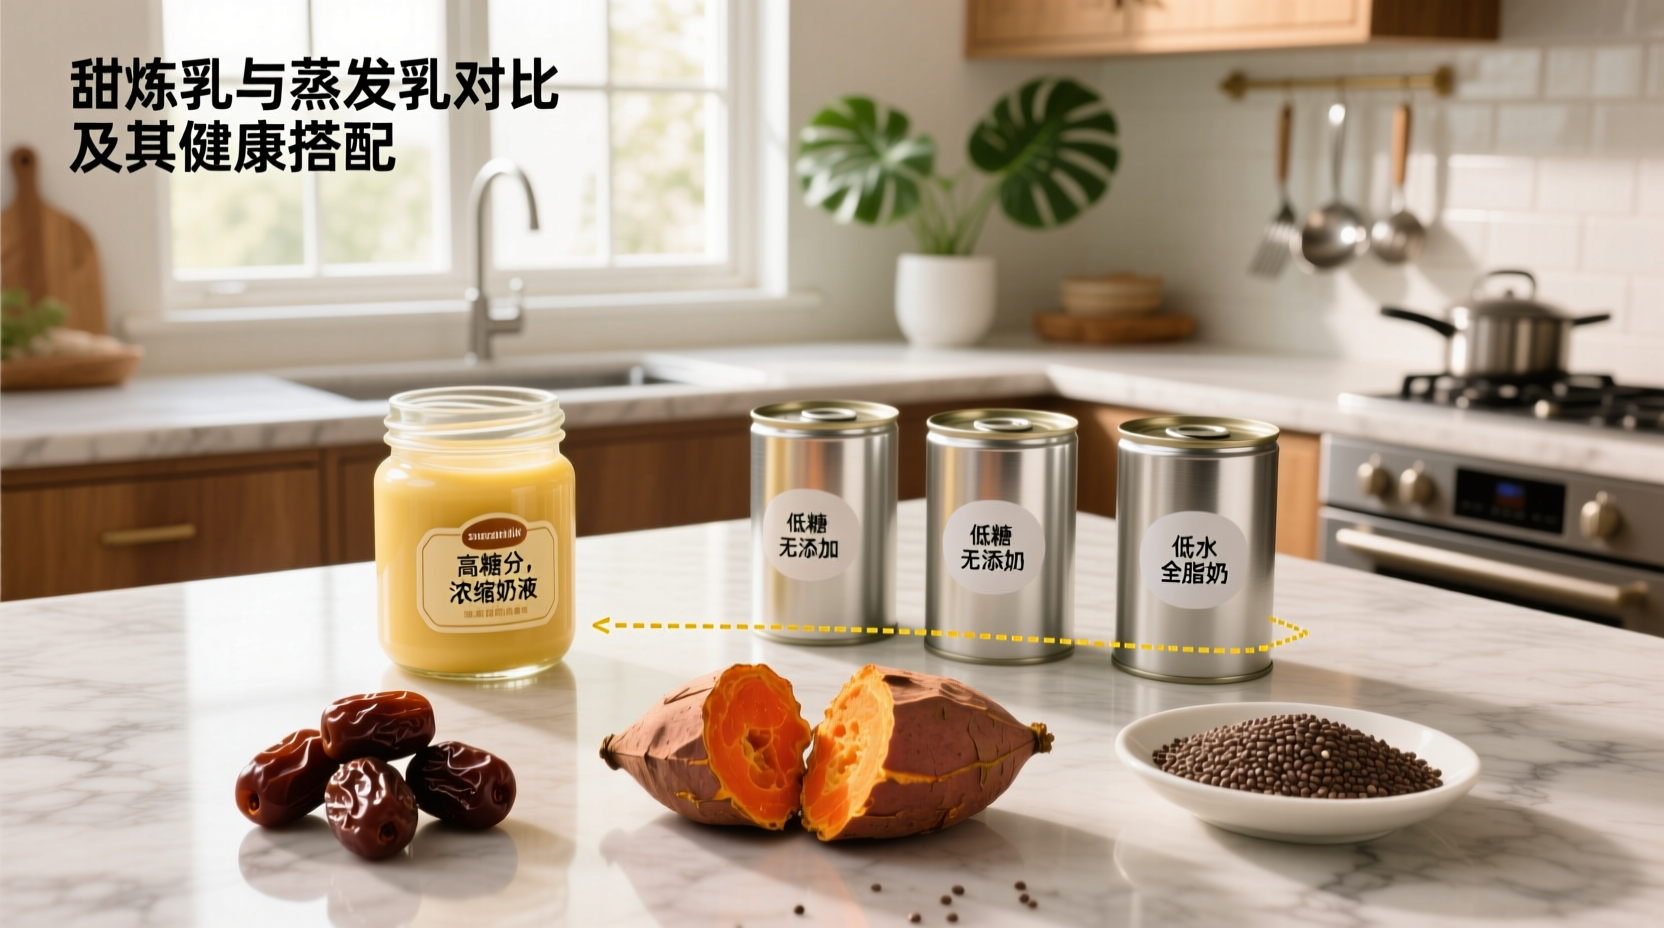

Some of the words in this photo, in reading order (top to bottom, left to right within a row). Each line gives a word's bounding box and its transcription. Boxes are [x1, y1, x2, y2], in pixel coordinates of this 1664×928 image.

[786, 511, 828, 535] 低糖
[968, 523, 1013, 547] 低糖
[779, 536, 839, 559] 无添加
[1171, 534, 1218, 559] 低水
[1161, 559, 1229, 585] 全脂奶
[449, 577, 538, 605] 浓缩奶液
